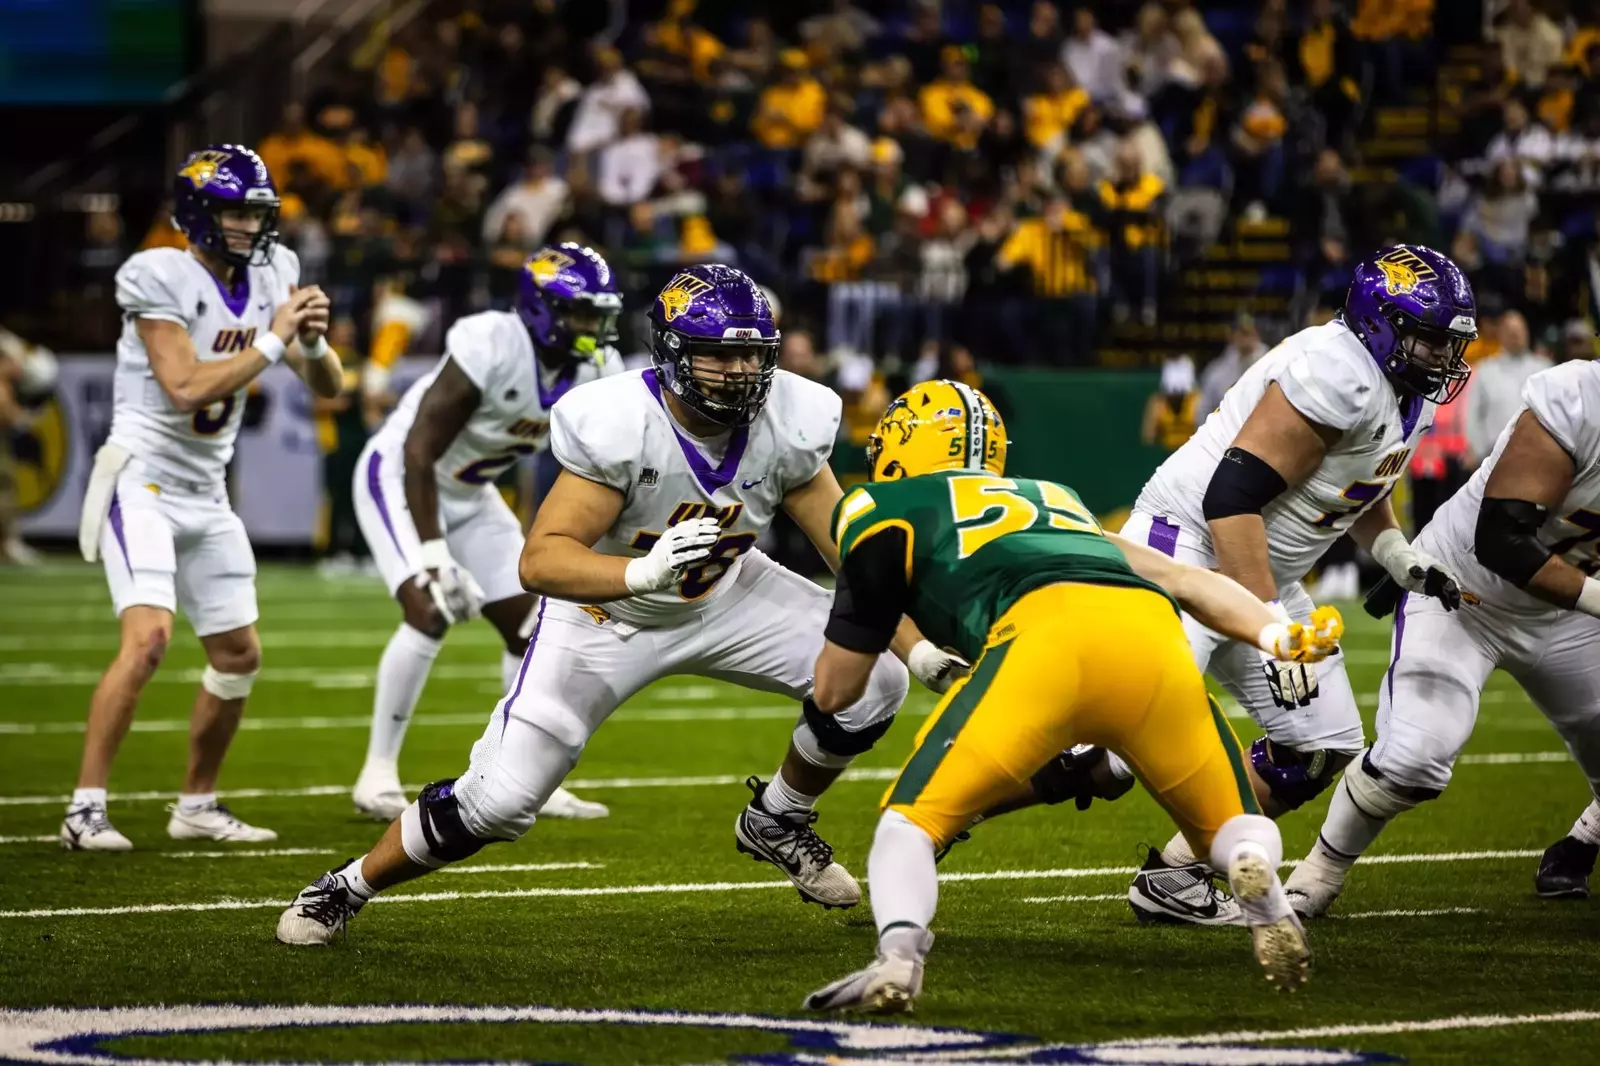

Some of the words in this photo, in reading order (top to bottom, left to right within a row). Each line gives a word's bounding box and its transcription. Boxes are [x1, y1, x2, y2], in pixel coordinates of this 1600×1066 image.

[1381, 248, 1440, 282] UNI
[211, 326, 257, 353] UNI
[735, 330, 752, 338] UNI
[972, 406, 982, 458] BISON
[948, 437, 963, 457] 5
[988, 440, 998, 459] 5
[1373, 448, 1411, 478] UNI
